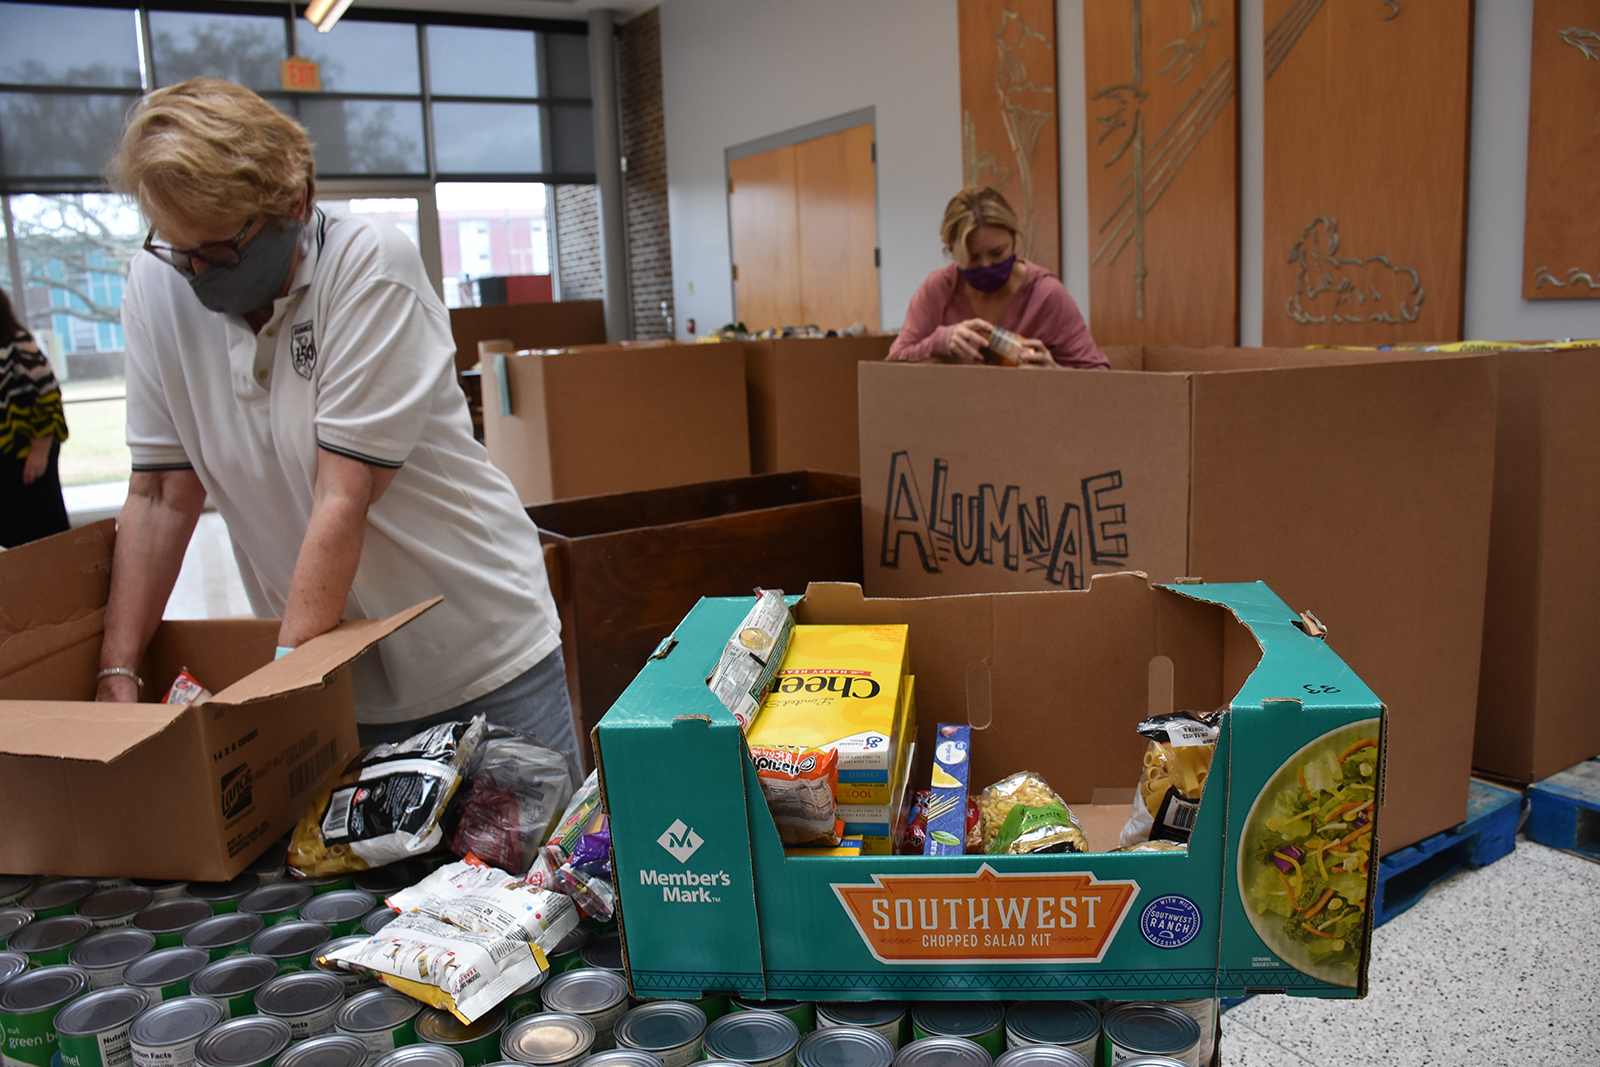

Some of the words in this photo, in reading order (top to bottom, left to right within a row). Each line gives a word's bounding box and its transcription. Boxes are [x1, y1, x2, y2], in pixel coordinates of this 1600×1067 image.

[288, 62, 316, 87] EXIT
[296, 344, 314, 366] 150
[880, 451, 1129, 591] ALUMNAE
[213, 752, 223, 763] 14
[224, 747, 231, 756] X
[238, 729, 258, 747] COUNT
[221, 769, 252, 817] Lance
[640, 870, 731, 887] Member's
[663, 887, 711, 903] Mark
[1160, 898, 1177, 906] WITH
[1178, 899, 1192, 911] MILD
[872, 896, 1102, 930] SOUTHWEST
[1150, 910, 1193, 924] SOUTHWEST
[1150, 918, 1190, 934] RANCH
[922, 934, 978, 947] CHOPPED
[984, 934, 1025, 946] SALAD
[1031, 933, 1051, 946] KIT
[1148, 933, 1182, 946] DRESSING
[7, 1027, 20, 1035] cut
[8, 1035, 43, 1049] green
[151, 1051, 172, 1060] Facts
